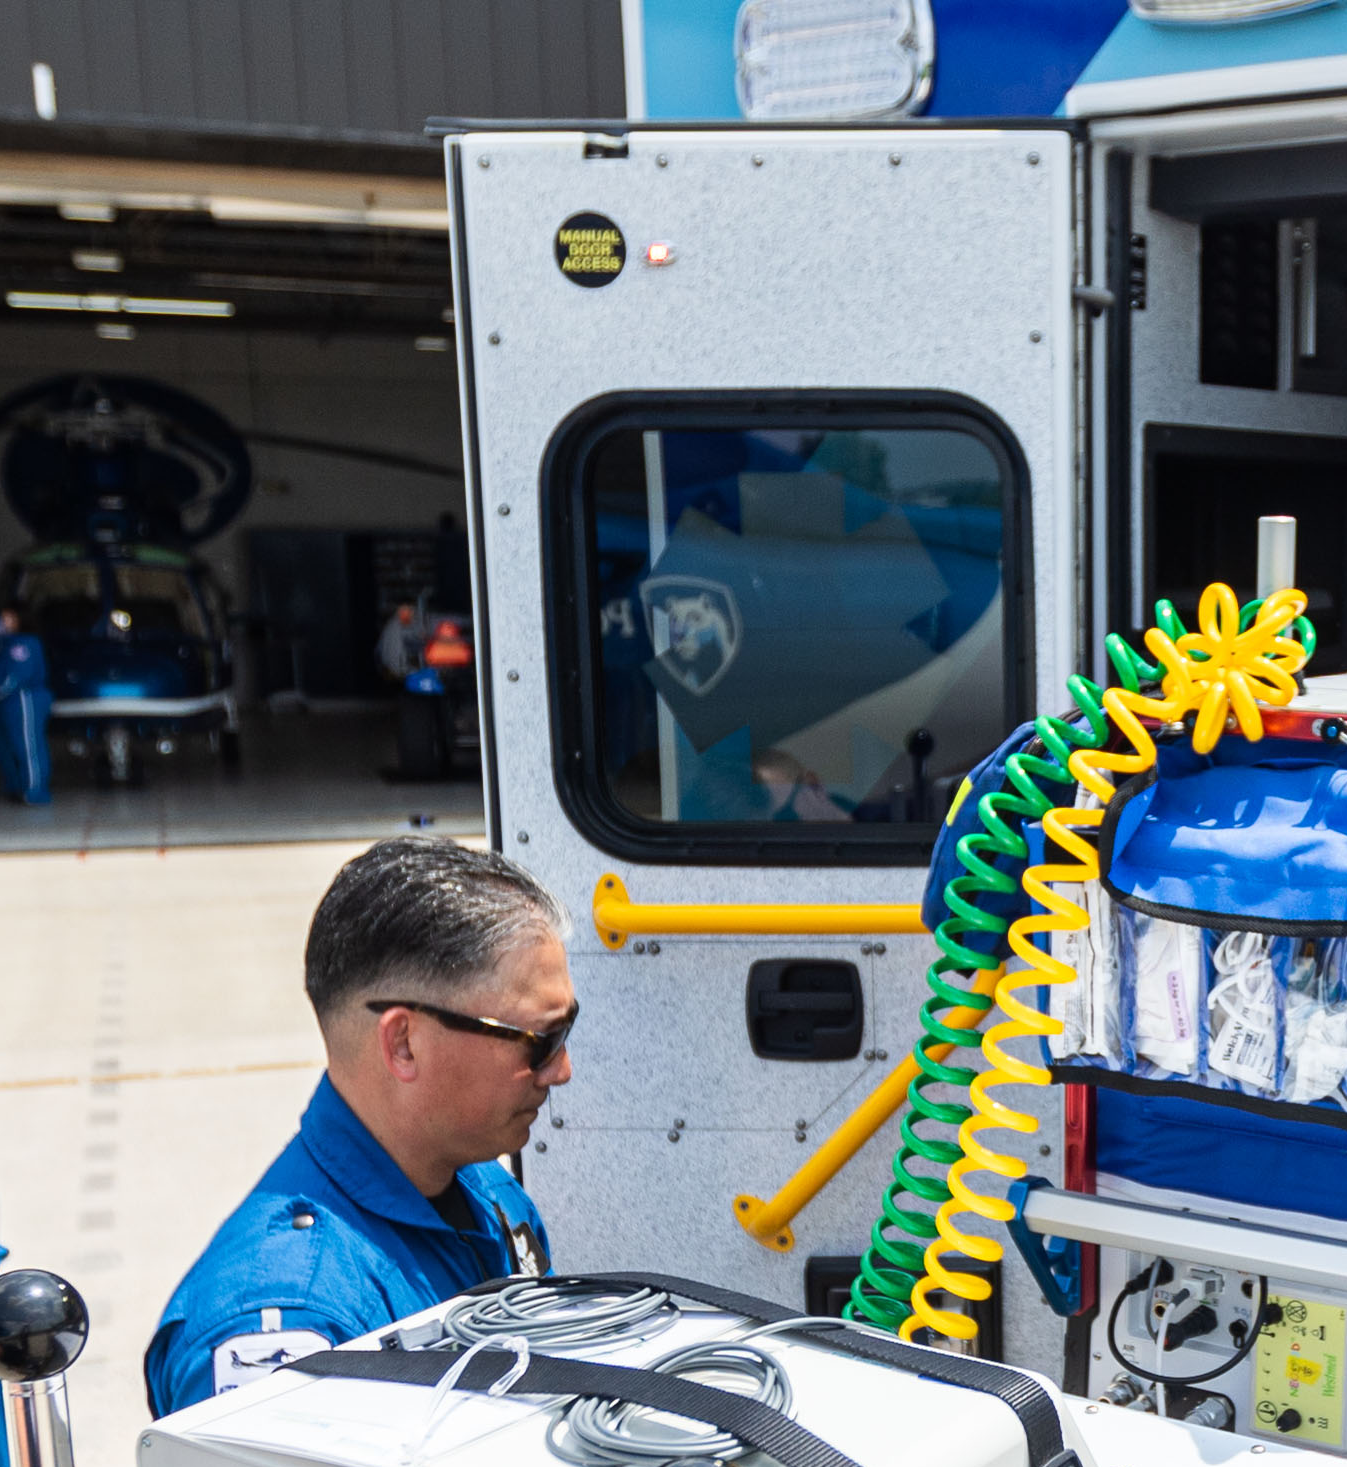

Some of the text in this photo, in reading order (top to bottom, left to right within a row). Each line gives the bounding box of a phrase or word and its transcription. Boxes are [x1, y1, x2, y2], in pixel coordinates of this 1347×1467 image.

[558, 228, 622, 246] MANUAL
[568, 242, 613, 257] DOOR
[561, 255, 622, 273] ACCESS
